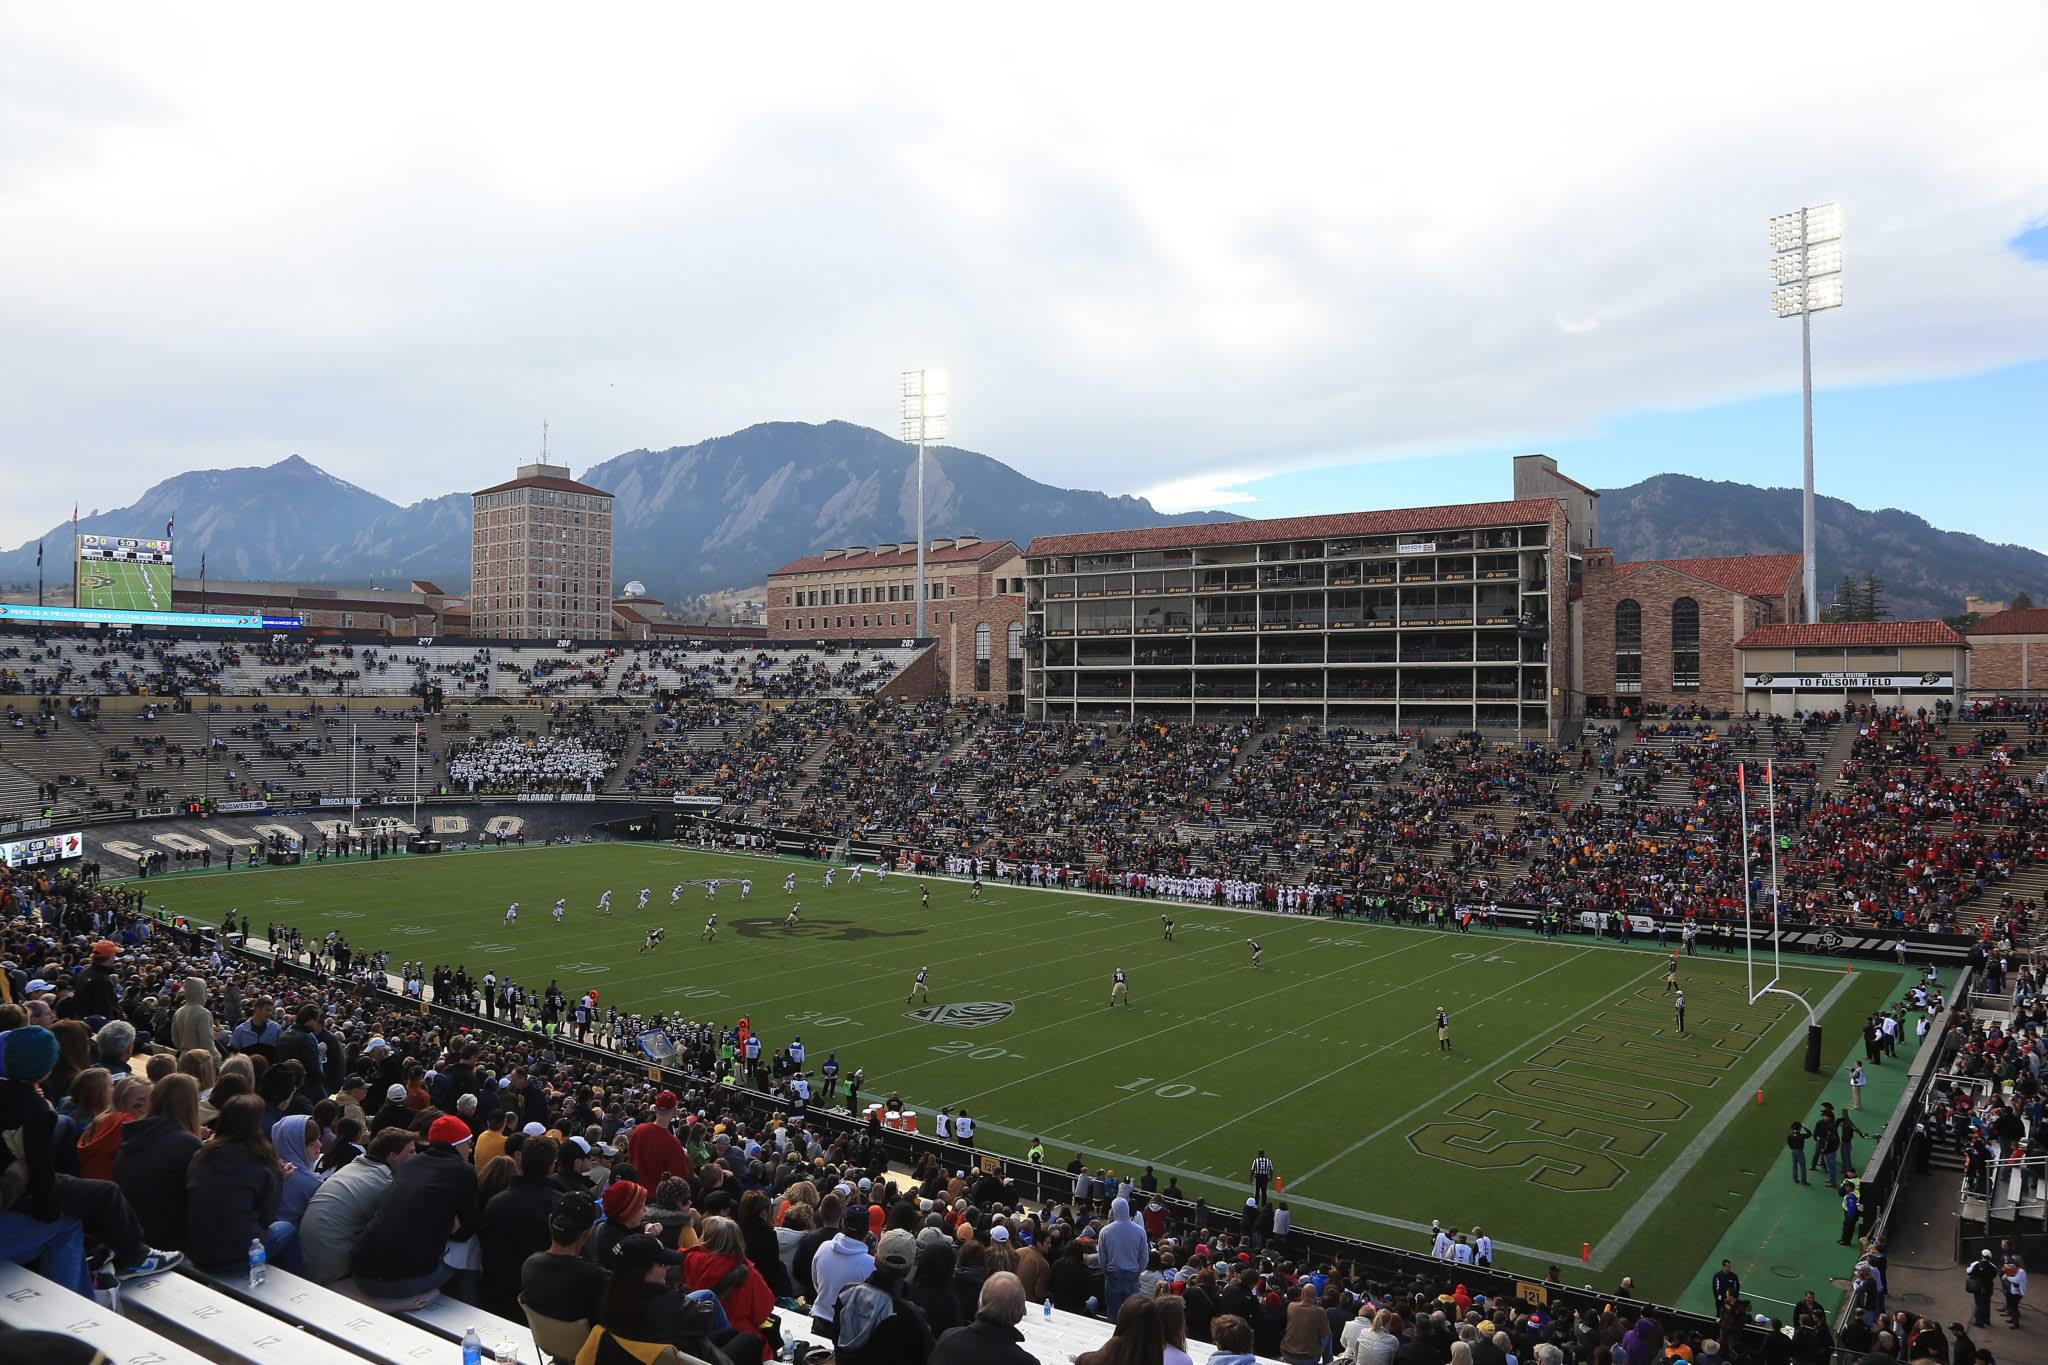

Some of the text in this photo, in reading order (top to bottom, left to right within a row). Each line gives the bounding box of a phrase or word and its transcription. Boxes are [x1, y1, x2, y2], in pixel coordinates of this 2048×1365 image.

[119, 539, 136, 548] 5:08
[145, 541, 158, 550] 45
[10, 608, 31, 616] PEPSI
[142, 615, 184, 623] UNIVERSITY
[197, 617, 237, 625] COLORADO
[1799, 678, 1892, 687] TO FOLSOM FIELD
[517, 793, 596, 802] COLORADO BUFFALOES
[233, 802, 253, 810] WEST
[31, 841, 44, 850] 5:08
[47, 839, 55, 847] 45
[784, 1011, 851, 1027] 30
[928, 1040, 1008, 1060] 20
[1114, 1077, 1198, 1099] 10
[1523, 1290, 1540, 1304] 121
